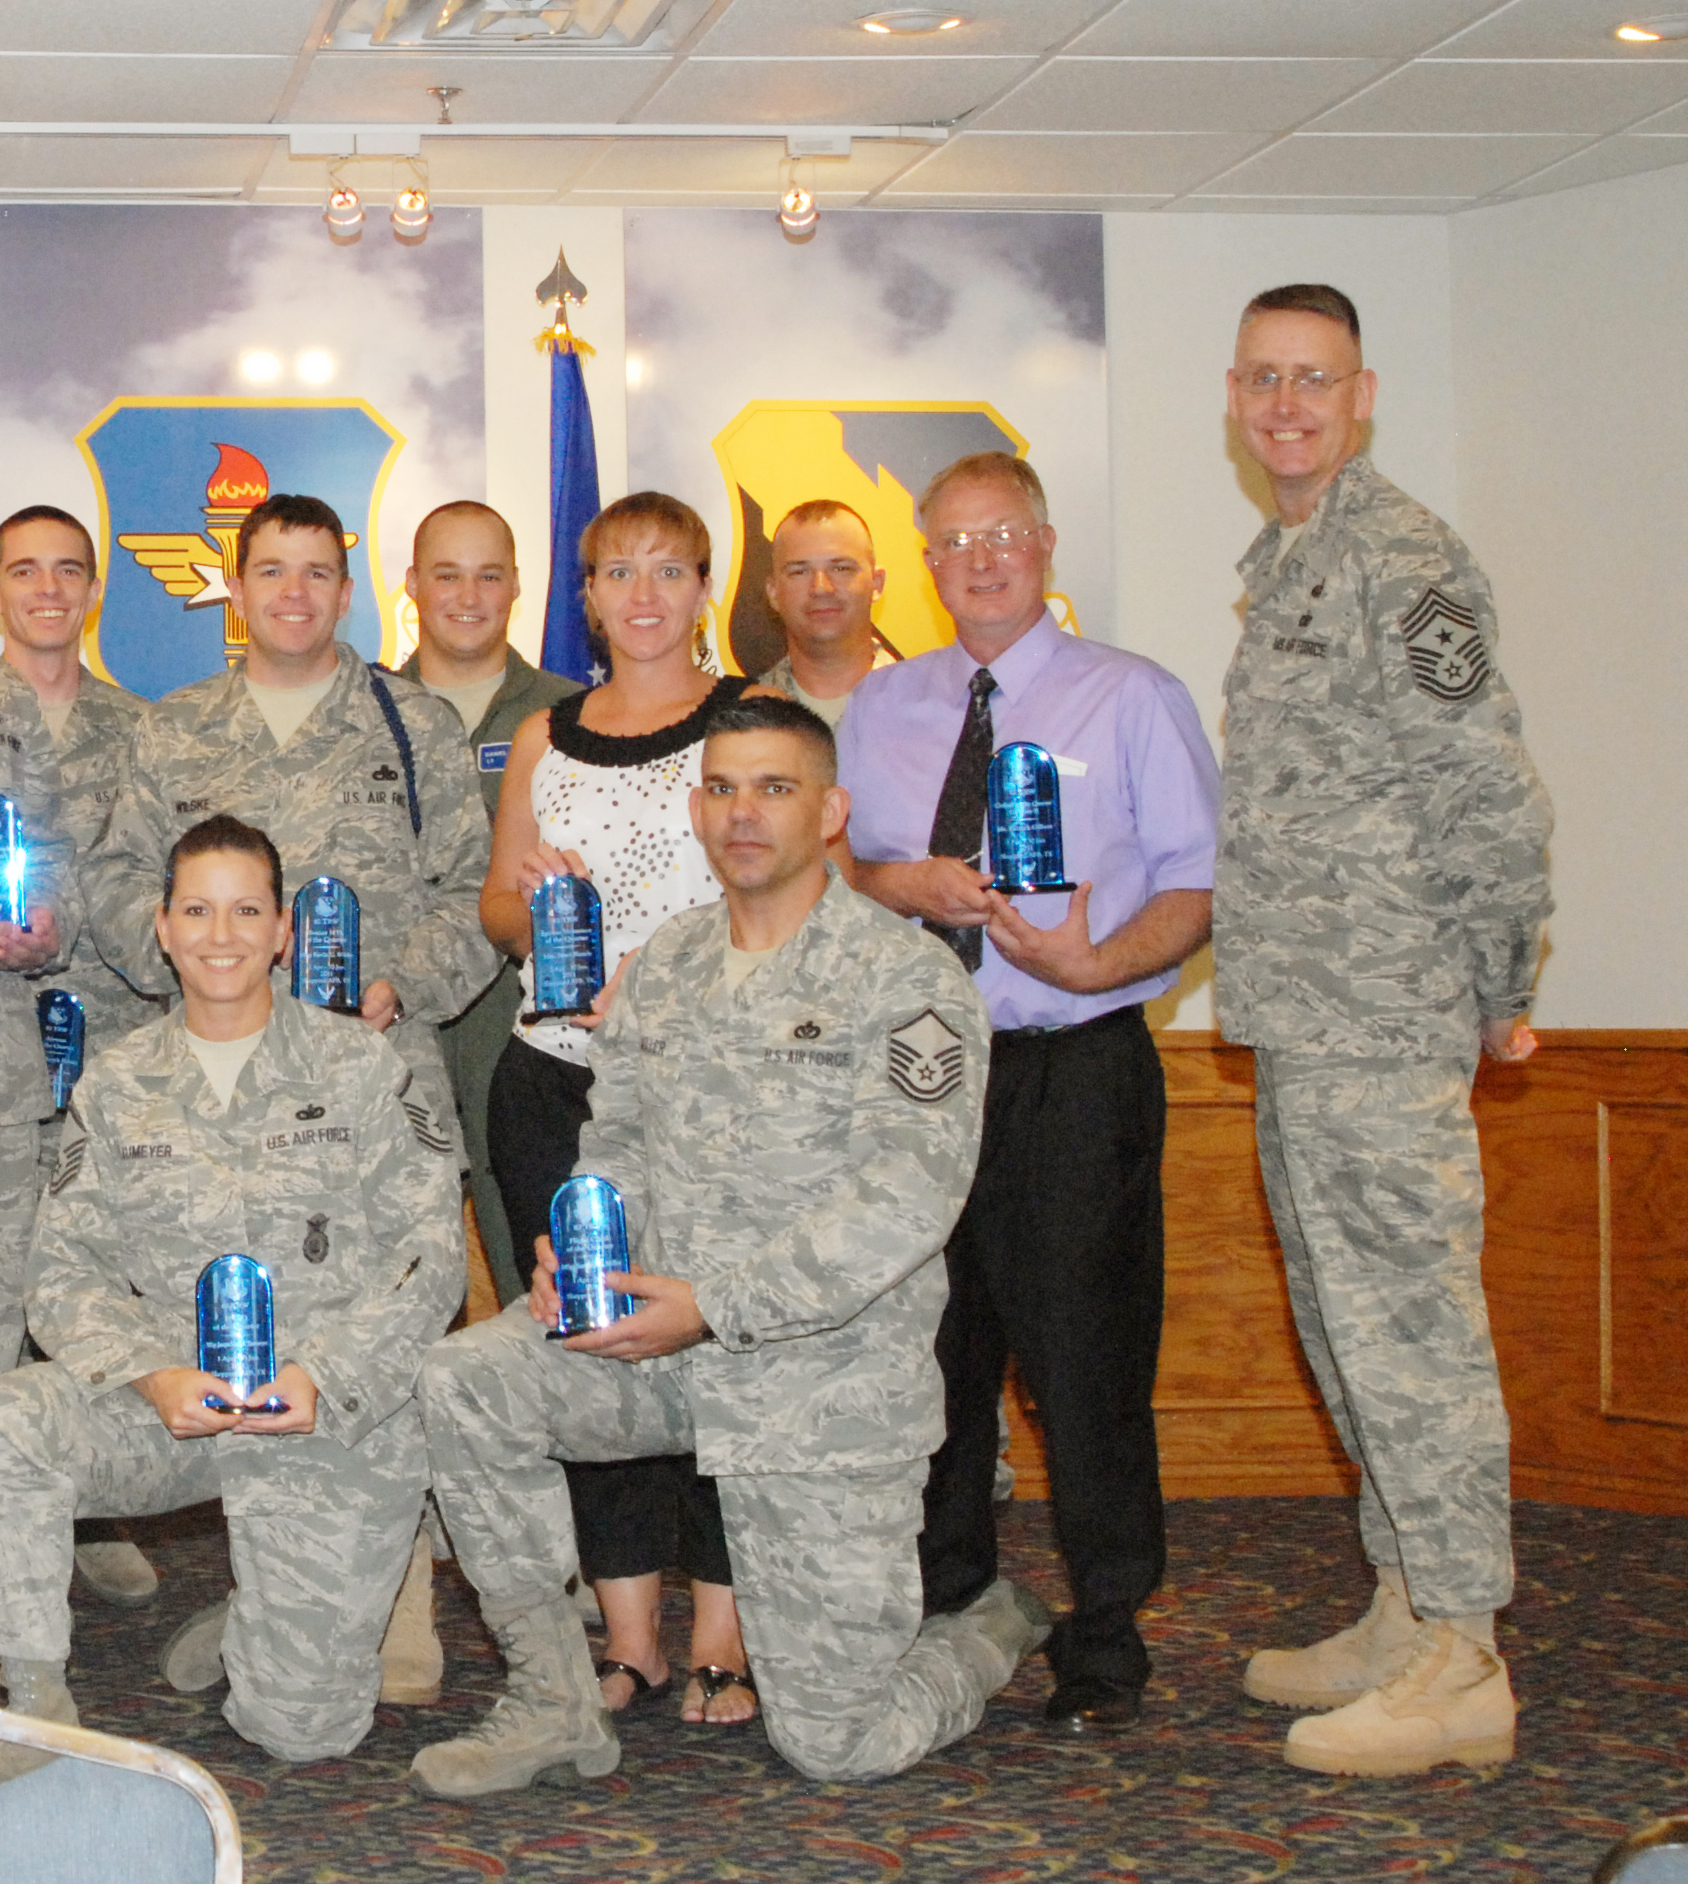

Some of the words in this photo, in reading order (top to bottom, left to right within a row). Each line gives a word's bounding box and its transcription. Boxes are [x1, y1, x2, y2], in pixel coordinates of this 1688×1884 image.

[367, 791, 387, 804] AIR
[787, 1050, 806, 1065] AIR
[808, 1050, 851, 1067] FORCE
[266, 1134, 290, 1150] U.S.
[292, 1129, 316, 1146] AIR
[318, 1127, 351, 1143] FORCE
